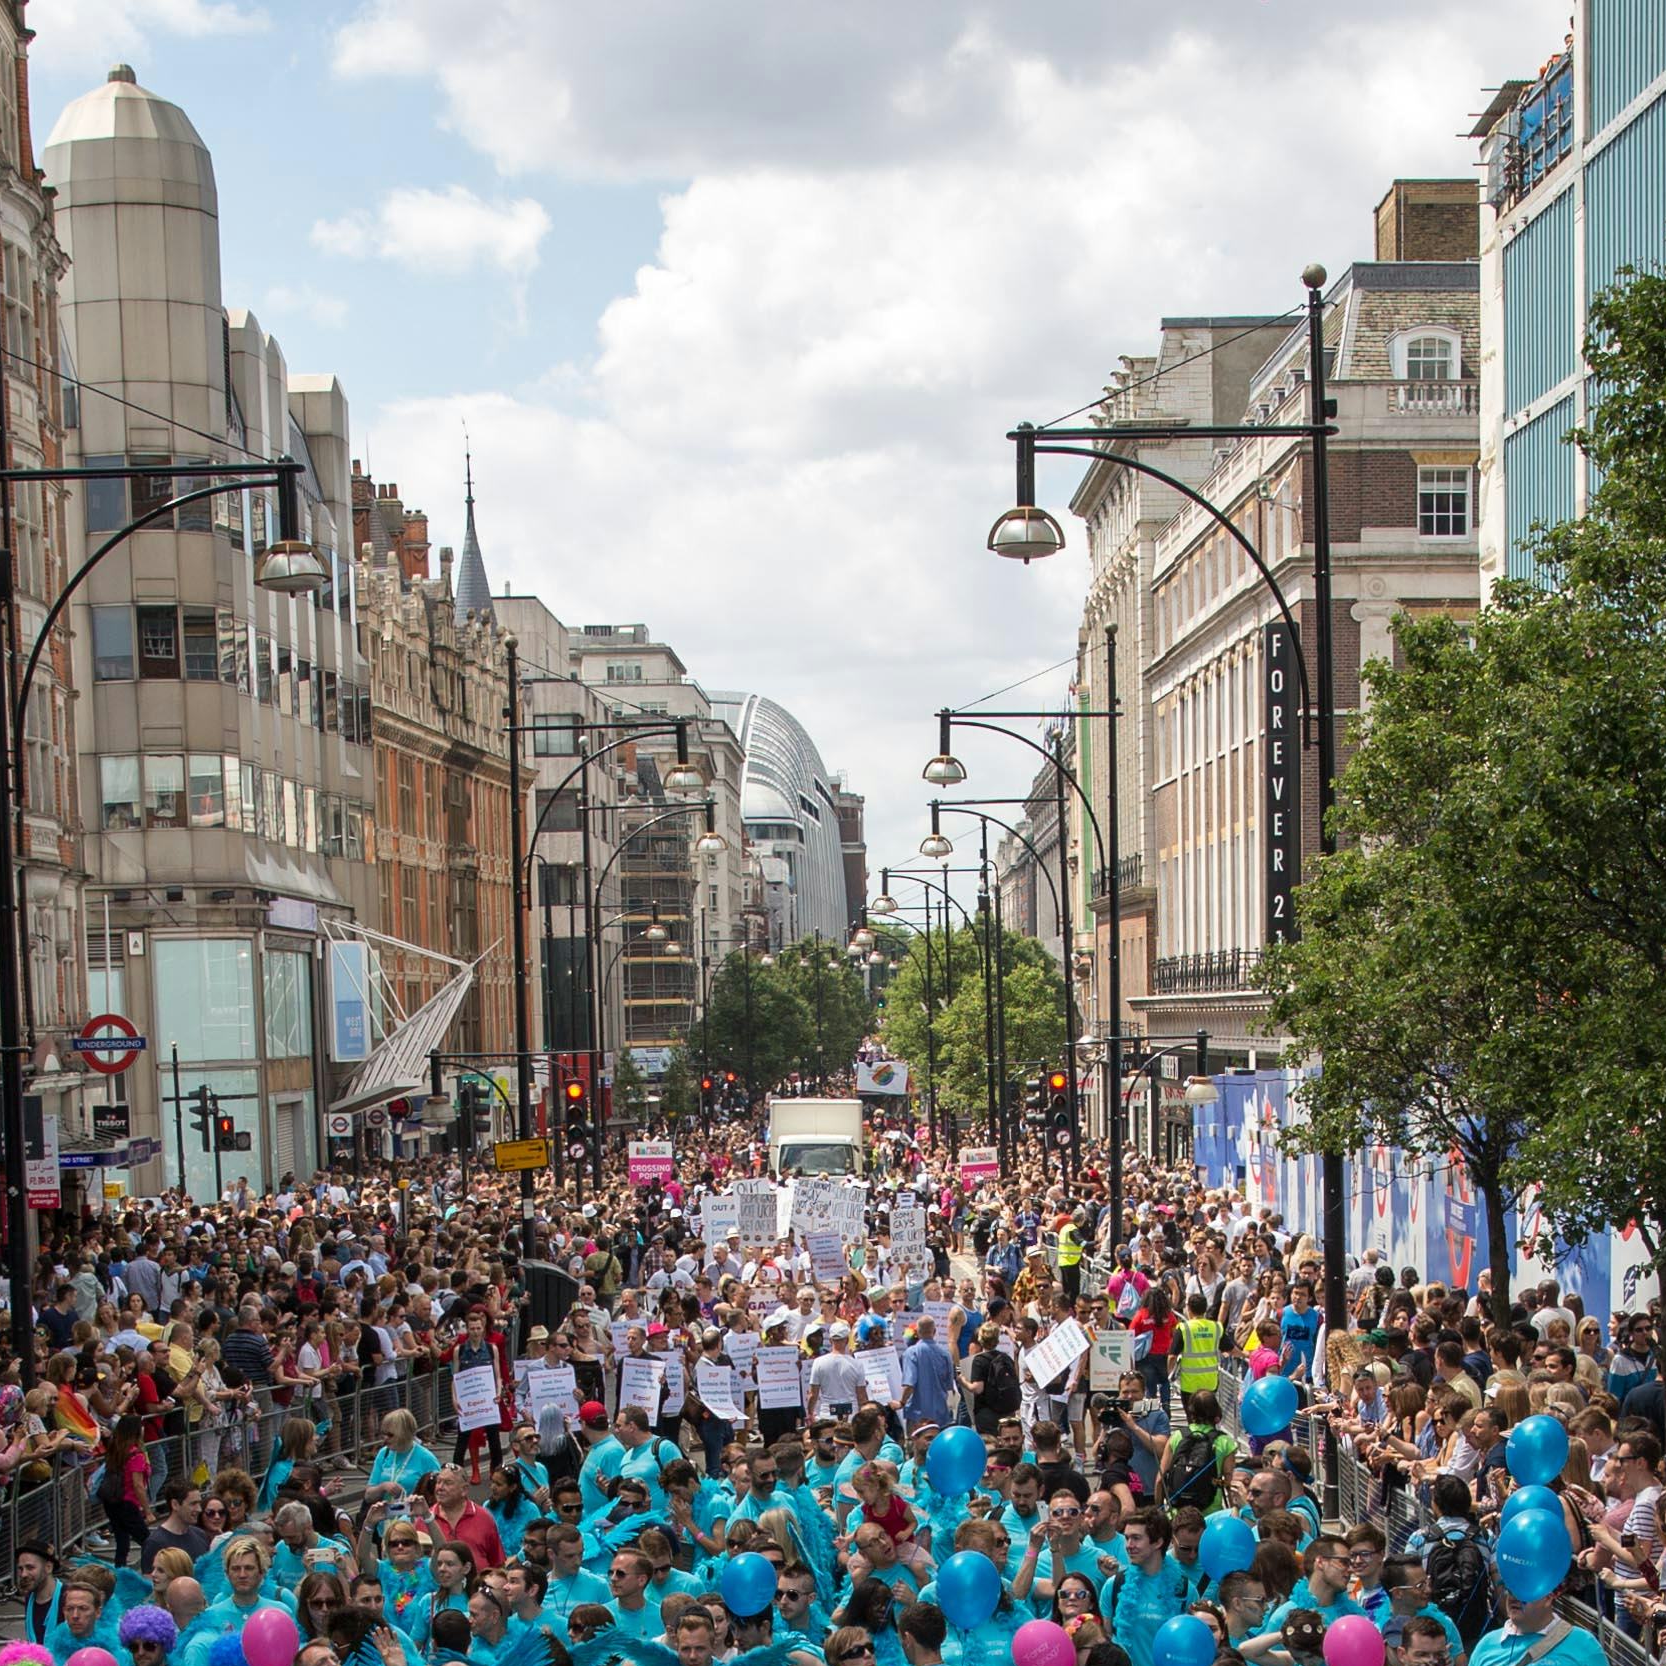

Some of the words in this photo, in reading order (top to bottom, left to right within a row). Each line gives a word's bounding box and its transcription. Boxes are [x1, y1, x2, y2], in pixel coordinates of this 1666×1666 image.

[1271, 633, 1285, 872] FOREVER
[77, 1039, 141, 1049] UNDERGROUND
[96, 1119, 127, 1127] TISSOT
[631, 1164, 671, 1172] CROSSING
[639, 1172, 664, 1180] POINT
[757, 1204, 776, 1218] UKIP
[846, 1203, 865, 1219] UKIP
[893, 1211, 916, 1219] SOME
[893, 1219, 916, 1229] GAYS
[632, 1393, 651, 1401] Equal
[467, 1399, 487, 1407] Equal
[463, 1406, 494, 1417] Marriage
